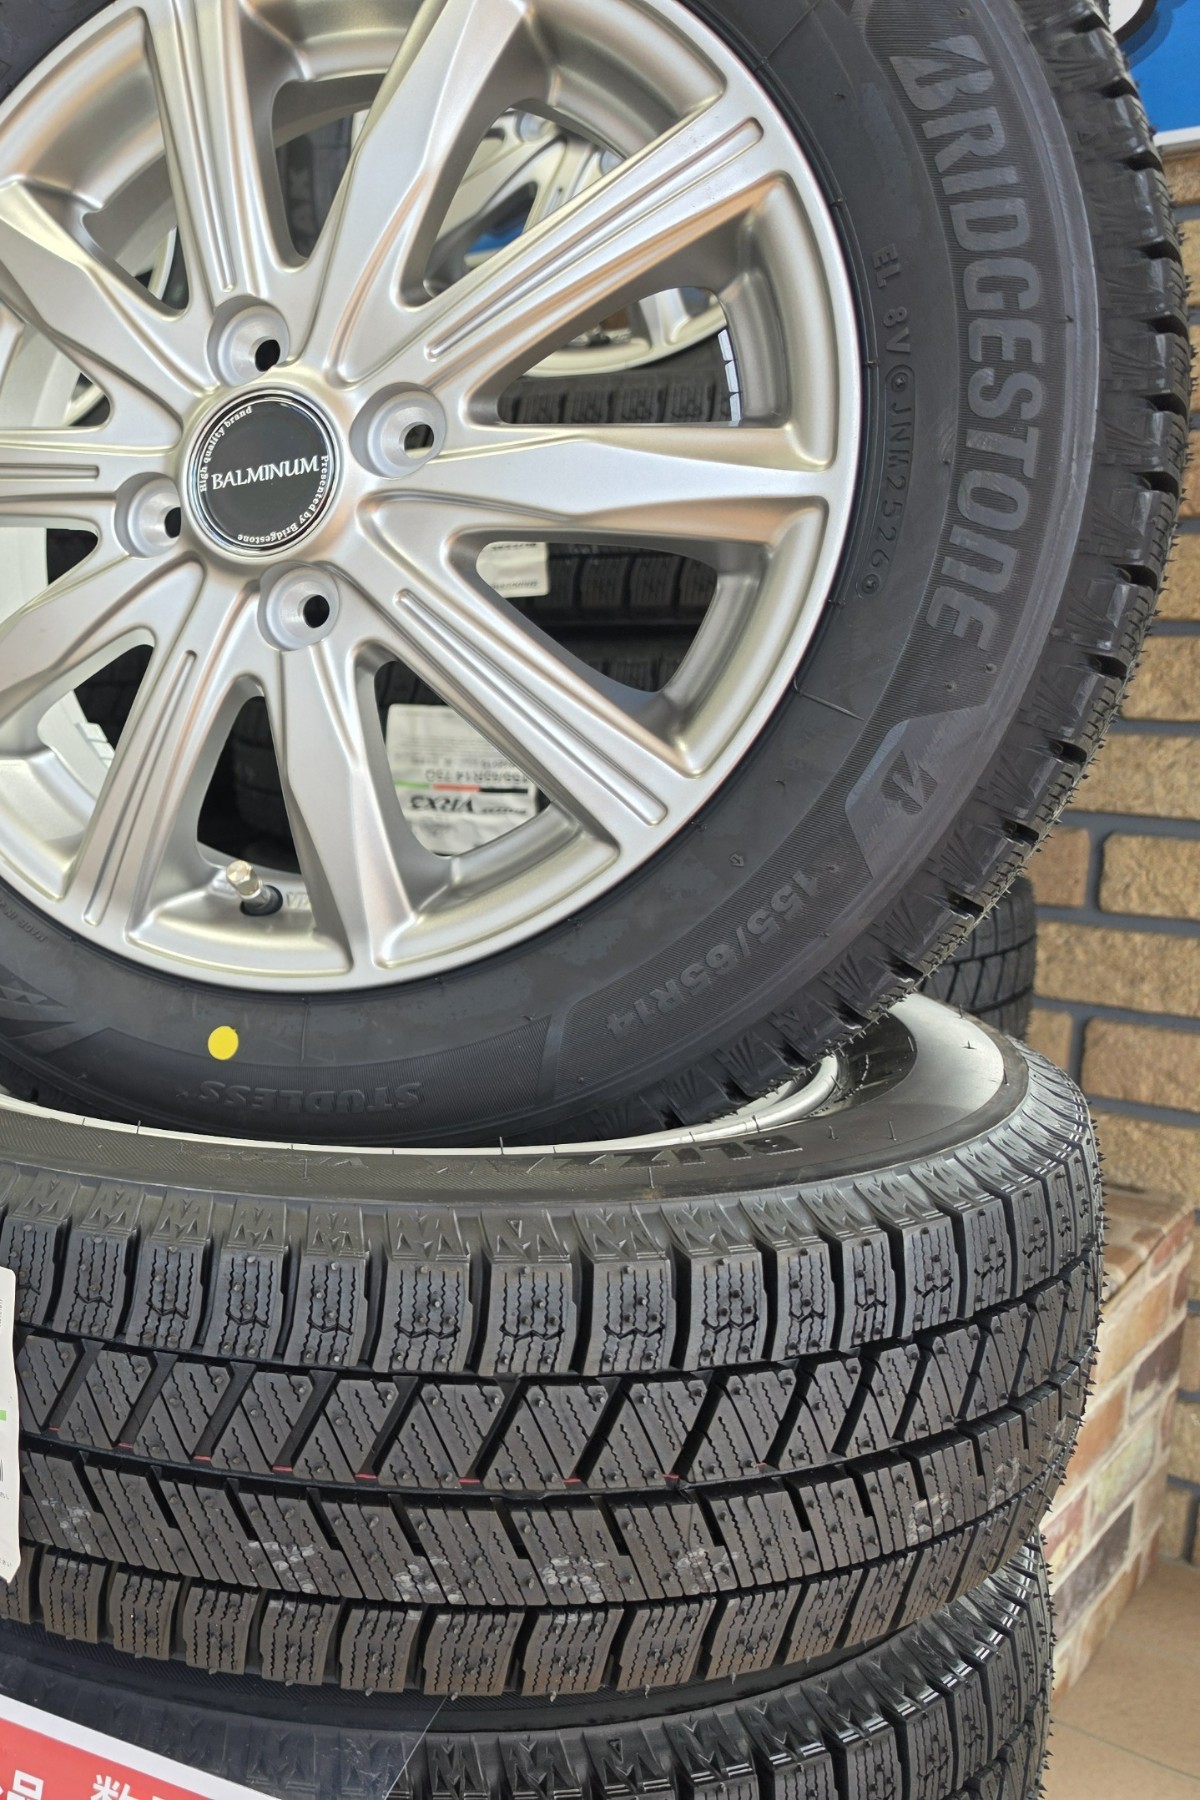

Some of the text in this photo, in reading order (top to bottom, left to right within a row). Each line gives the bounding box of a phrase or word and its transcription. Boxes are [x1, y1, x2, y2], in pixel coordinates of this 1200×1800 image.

[872, 243, 911, 354] EL 8V
[888, 34, 1043, 651] BRIDGESTONE
[199, 406, 252, 492] High quality brand
[211, 455, 319, 490] BALMINUM
[238, 455, 329, 544] Presented by Bridgestone
[411, 796, 473, 813] VRX3
[607, 870, 819, 1041] 155/65R14
[199, 1080, 421, 1114] STUDLESS
